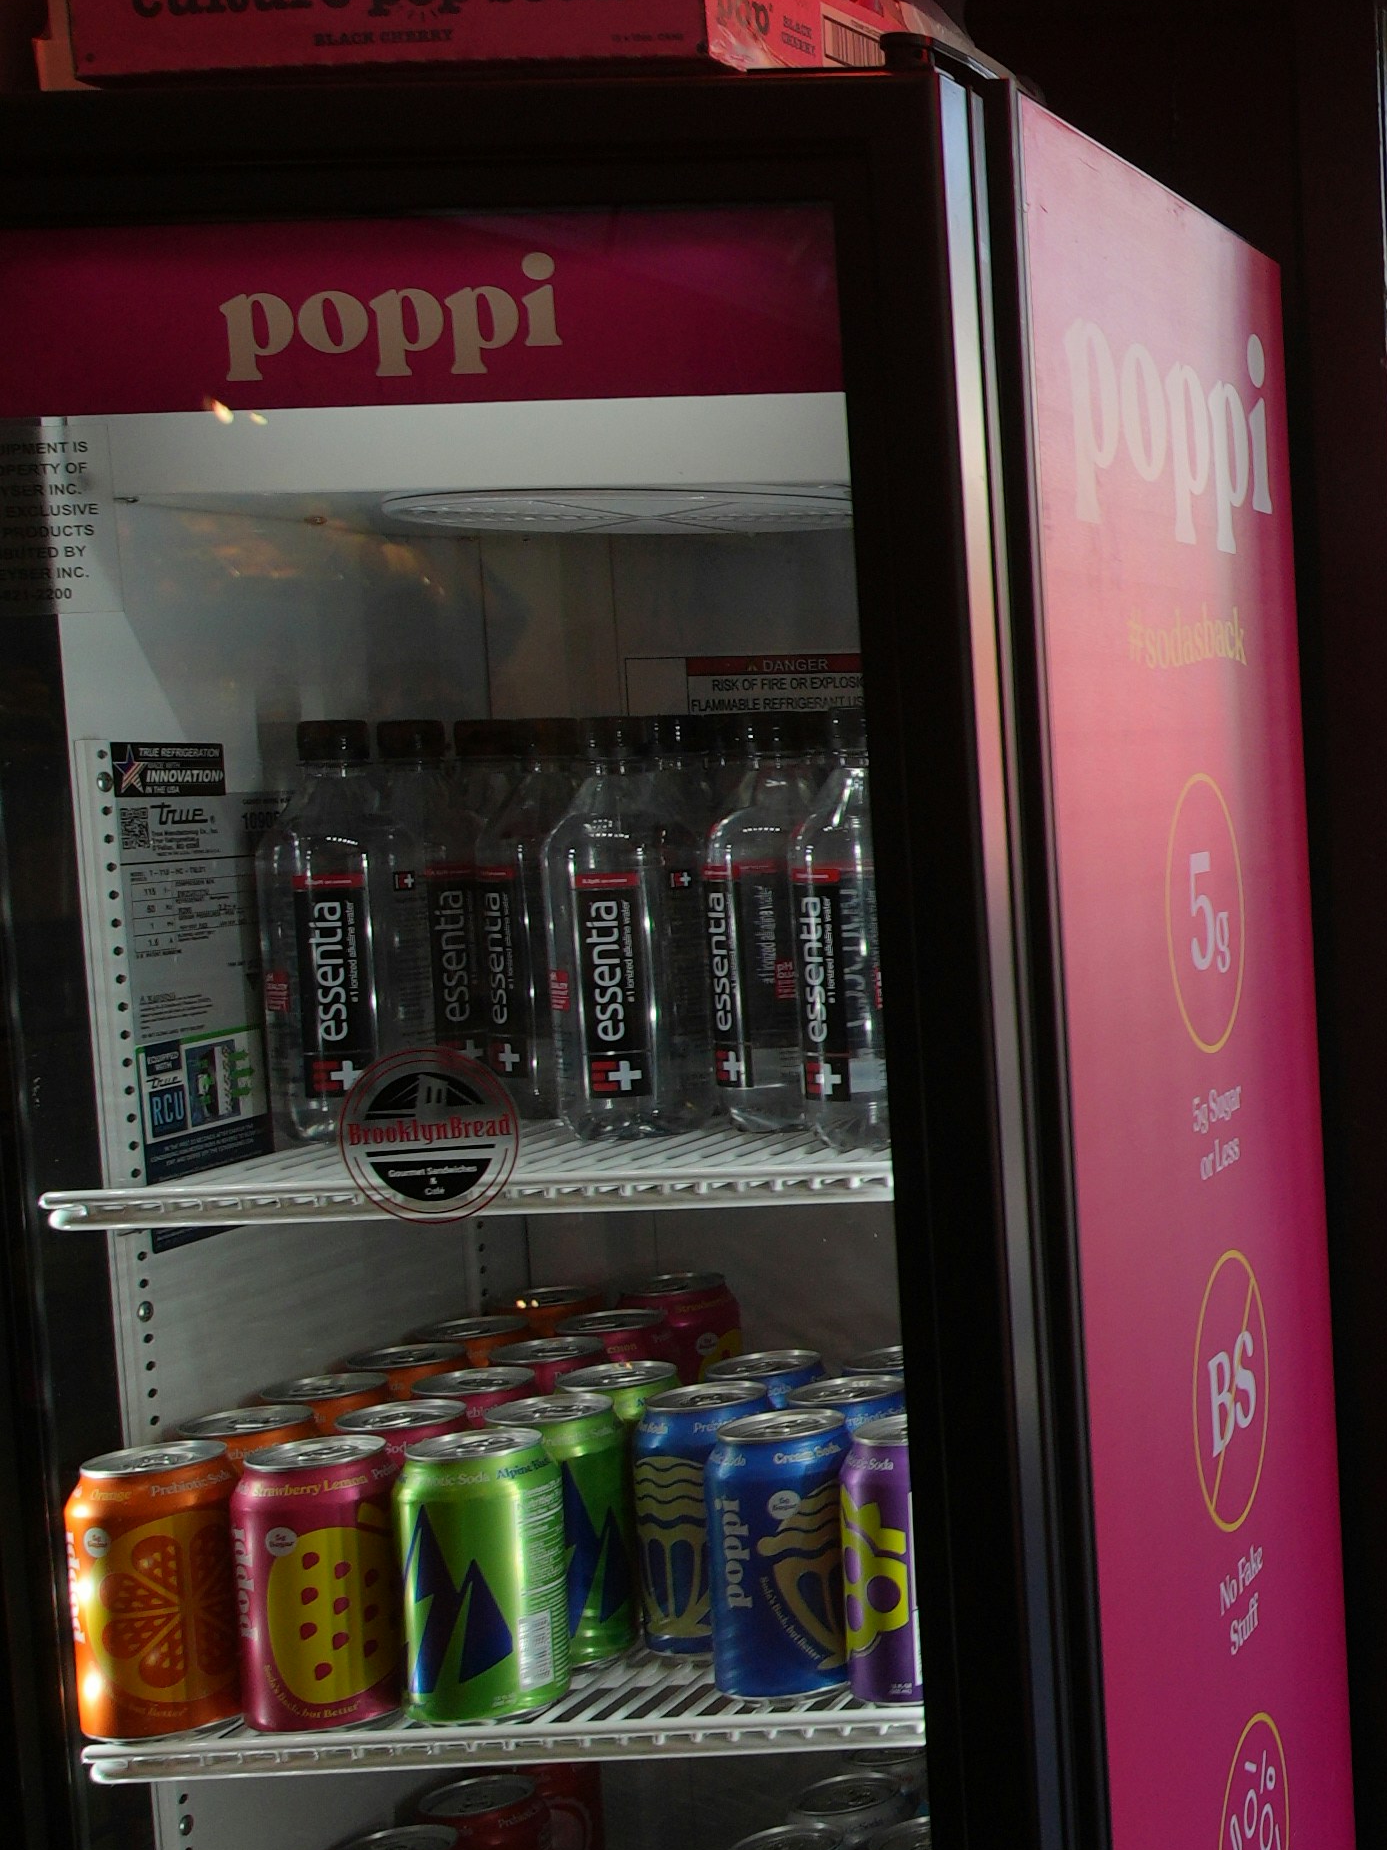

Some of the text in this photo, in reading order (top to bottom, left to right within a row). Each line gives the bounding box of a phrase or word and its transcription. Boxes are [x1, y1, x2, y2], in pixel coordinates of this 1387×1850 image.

[314, 29, 453, 46] BLACK CHERRY
[220, 252, 562, 381] poppi
[73, 440, 89, 453] IS
[1062, 317, 1274, 555] poppi
[65, 463, 89, 475] OF
[48, 483, 82, 496] INC.
[6, 502, 100, 518] EXCLUSIVE
[3, 524, 96, 538] PRODUCTS
[64, 545, 87, 558] BY
[56, 566, 90, 579] INC.
[1125, 600, 1249, 670] #sodasback
[763, 659, 829, 671] DANGER
[712, 677, 808, 691] RISK OF FIRE OR
[691, 696, 846, 712] FLAMMABLE REFRIGERANT
[138, 747, 220, 757] TRUE REFRIGERATION
[146, 769, 220, 783] INNOVATION
[1188, 850, 1232, 974] 5g
[434, 890, 471, 1022] essentia
[485, 892, 508, 1024] essentia
[708, 892, 733, 1031] essentia
[308, 901, 348, 1041] essentia
[586, 900, 625, 1042] essentia
[800, 896, 828, 1043] essentia
[153, 1090, 185, 1126] RCU
[1191, 1084, 1243, 1135] 5g Sugar
[347, 1113, 513, 1145] BrooklynBread
[388, 1165, 477, 1178] Gourmet Sandwiches
[1199, 1137, 1241, 1182] or Less
[425, 1186, 446, 1196] Café
[1206, 1330, 1257, 1459] BS
[773, 1442, 842, 1465] Cream Soda
[868, 1458, 895, 1472] Soda
[456, 1469, 490, 1486] Soda
[496, 1458, 532, 1480] Alpine
[89, 1476, 204, 1501] Orange Prebiotic
[253, 1473, 369, 1499] Strawberry Lemon
[714, 1498, 753, 1609] poppi
[1217, 1542, 1265, 1617] No Fake
[1228, 1591, 1261, 1658] Stuff
